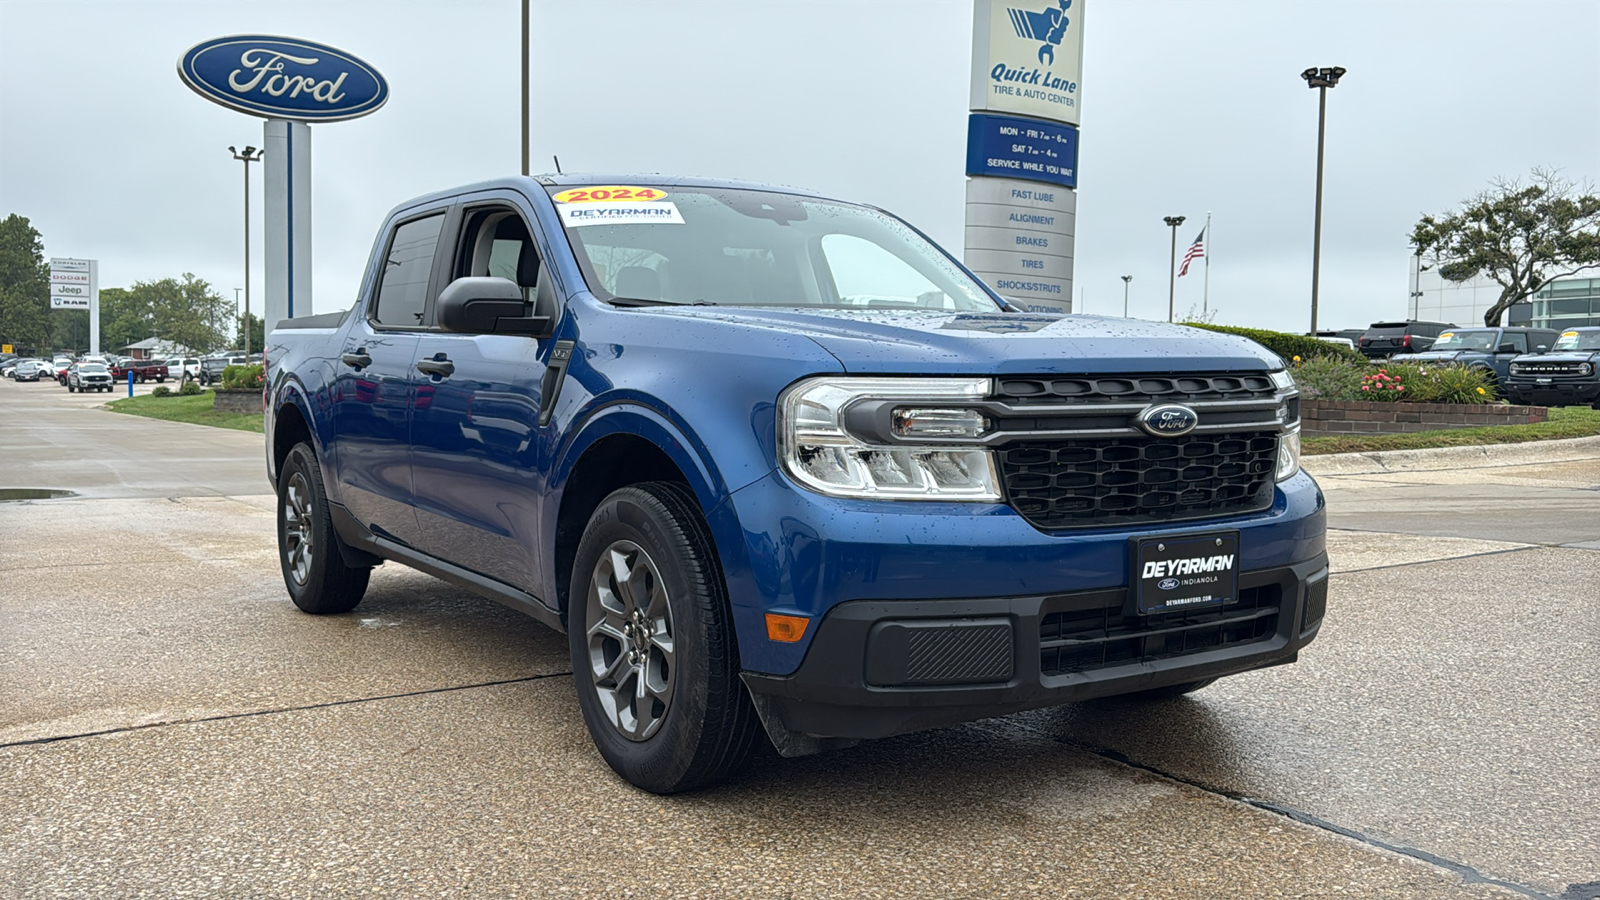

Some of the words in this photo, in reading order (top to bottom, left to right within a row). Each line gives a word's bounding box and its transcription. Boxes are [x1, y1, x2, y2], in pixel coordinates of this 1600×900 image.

[228, 48, 349, 104] Ford
[990, 63, 1041, 85] Quick
[1042, 71, 1077, 93] Lane
[993, 85, 1014, 96] TIRE
[1015, 87, 1022, 97] &
[1023, 89, 1047, 101] AUTO
[1047, 93, 1075, 108] CENTER
[999, 126, 1018, 136] MON
[1026, 129, 1038, 139] FRI
[1011, 144, 1026, 153] SAT
[987, 158, 1021, 169] SERVICE
[1022, 161, 1044, 172] WHILE
[1045, 164, 1059, 174] YOU
[1060, 168, 1073, 177] WAIT
[568, 189, 657, 202] 2024
[1011, 189, 1032, 200] FAST
[1034, 192, 1054, 202] LUBE
[570, 208, 671, 218] DEYARMAN
[1009, 213, 1055, 225] ALIGNMENT
[1016, 236, 1048, 248] BRAKES
[1021, 259, 1044, 269] TIRES
[58, 285, 82, 295] Jeep
[997, 280, 1061, 294] SHOCKS/STRUTS
[1028, 304, 1063, 313] DITIONING
[1158, 411, 1188, 429] Ford
[1142, 554, 1234, 579] DEYARMAN
[1181, 575, 1218, 586] INDIANOLA
[1166, 595, 1212, 606] DEYARMANFORD.COM
